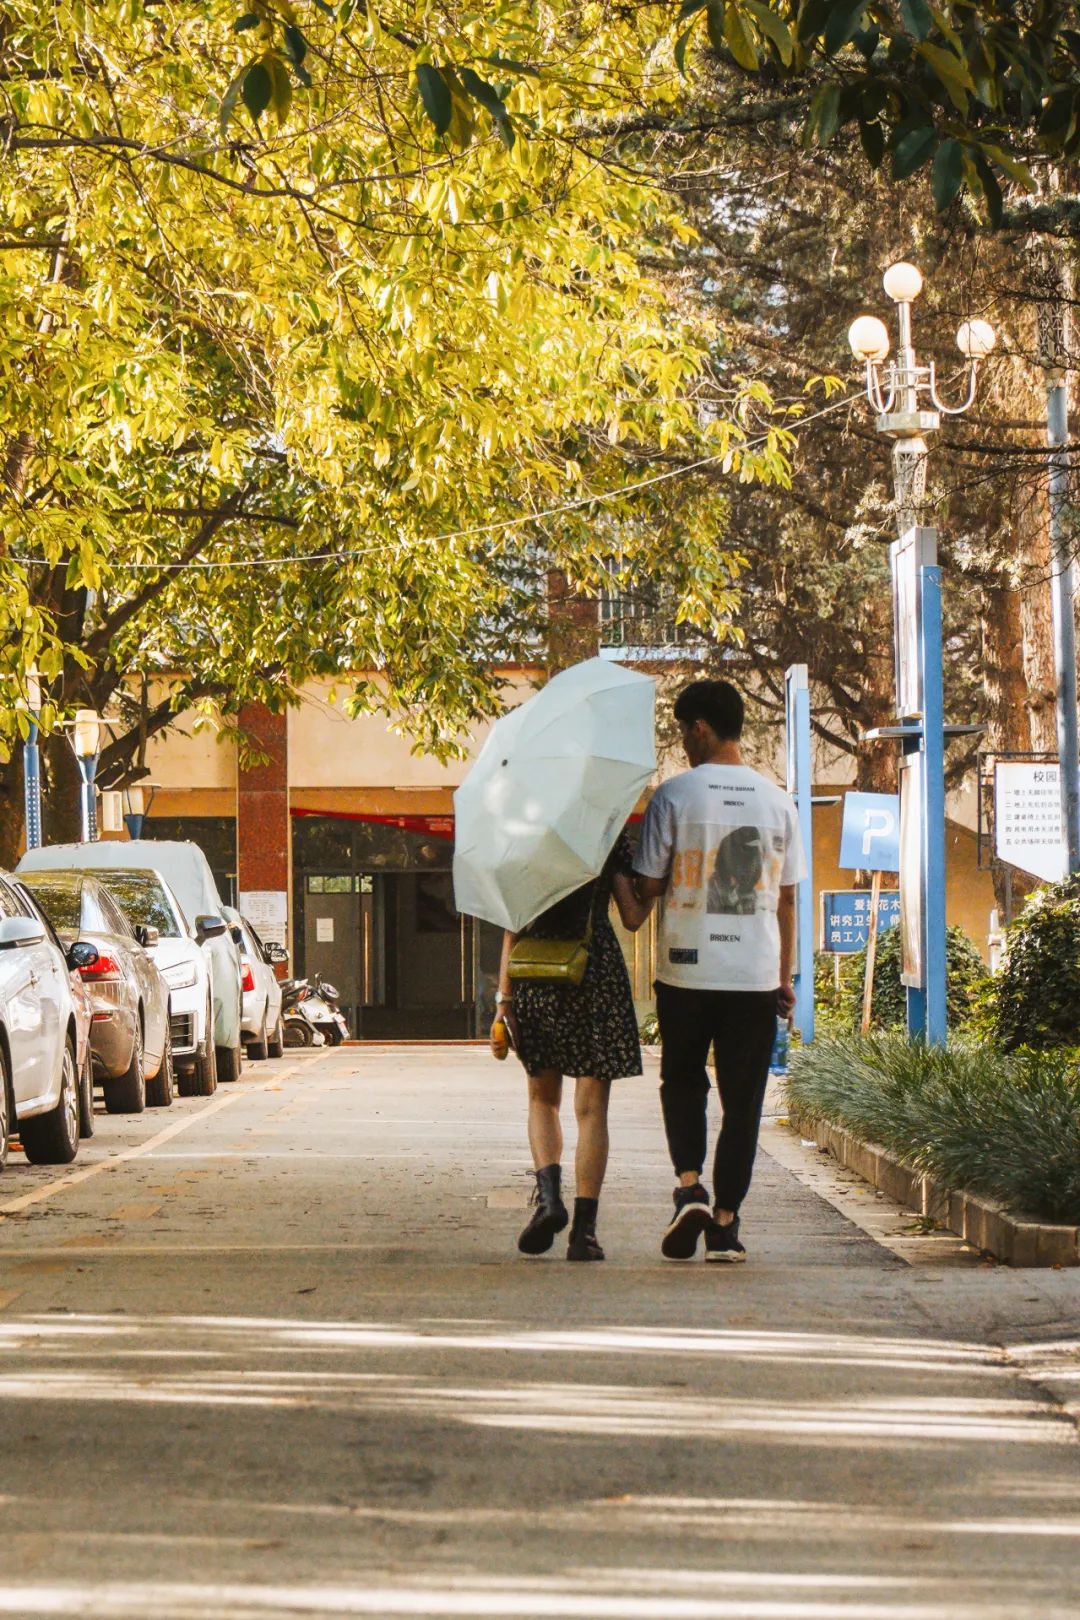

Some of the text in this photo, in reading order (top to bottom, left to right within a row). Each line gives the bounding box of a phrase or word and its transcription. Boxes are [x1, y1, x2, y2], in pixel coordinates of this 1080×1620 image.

[861, 809, 895, 855] P
[709, 933, 741, 942] BROKEN
[831, 931, 865, 943] 员工人
